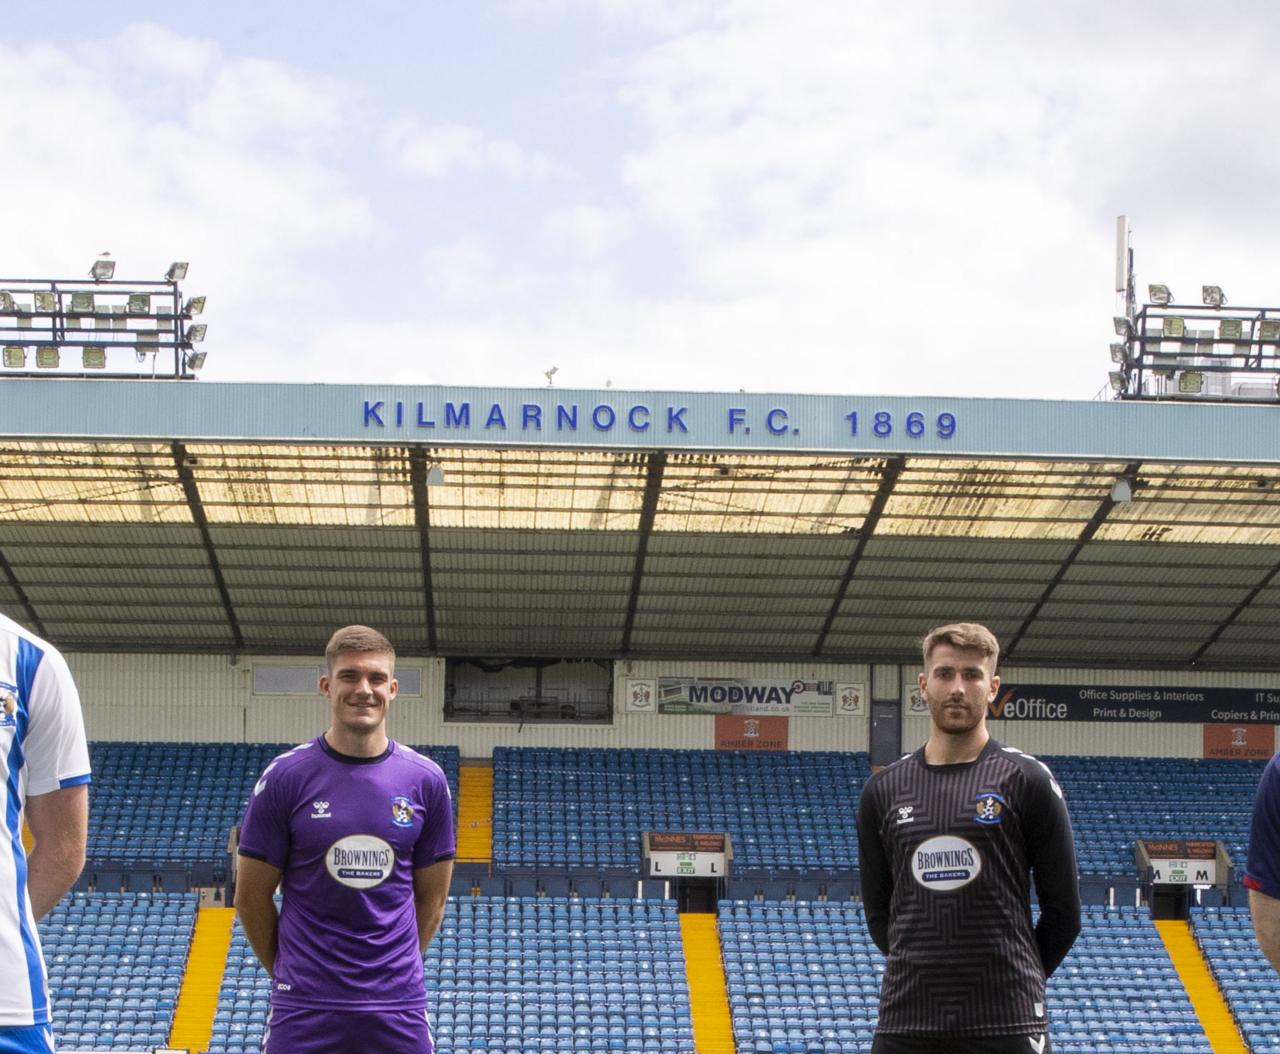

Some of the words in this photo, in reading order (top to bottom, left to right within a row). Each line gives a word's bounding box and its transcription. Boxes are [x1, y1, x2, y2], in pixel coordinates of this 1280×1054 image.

[362, 400, 689, 433] KILMARNOCK
[845, 410, 957, 438] 1869
[688, 684, 795, 705] MODWAY
[1078, 689, 1108, 700] Office
[1109, 689, 1152, 702] Supplies
[1153, 690, 1161, 701] &
[1163, 690, 1205, 702] Interiors
[1255, 692, 1265, 702] IT
[1092, 707, 1117, 717] Print
[1119, 708, 1127, 718] &
[1128, 708, 1162, 720] Design
[1210, 709, 1249, 721] Copiers
[1250, 711, 1258, 720] &
[333, 846, 391, 868] BROWNINGS
[916, 847, 974, 871] BROWNINGS
[654, 861, 662, 873] L
[711, 862, 718, 874] L
[924, 872, 939, 880] THE
[1195, 869, 1209, 881] M
